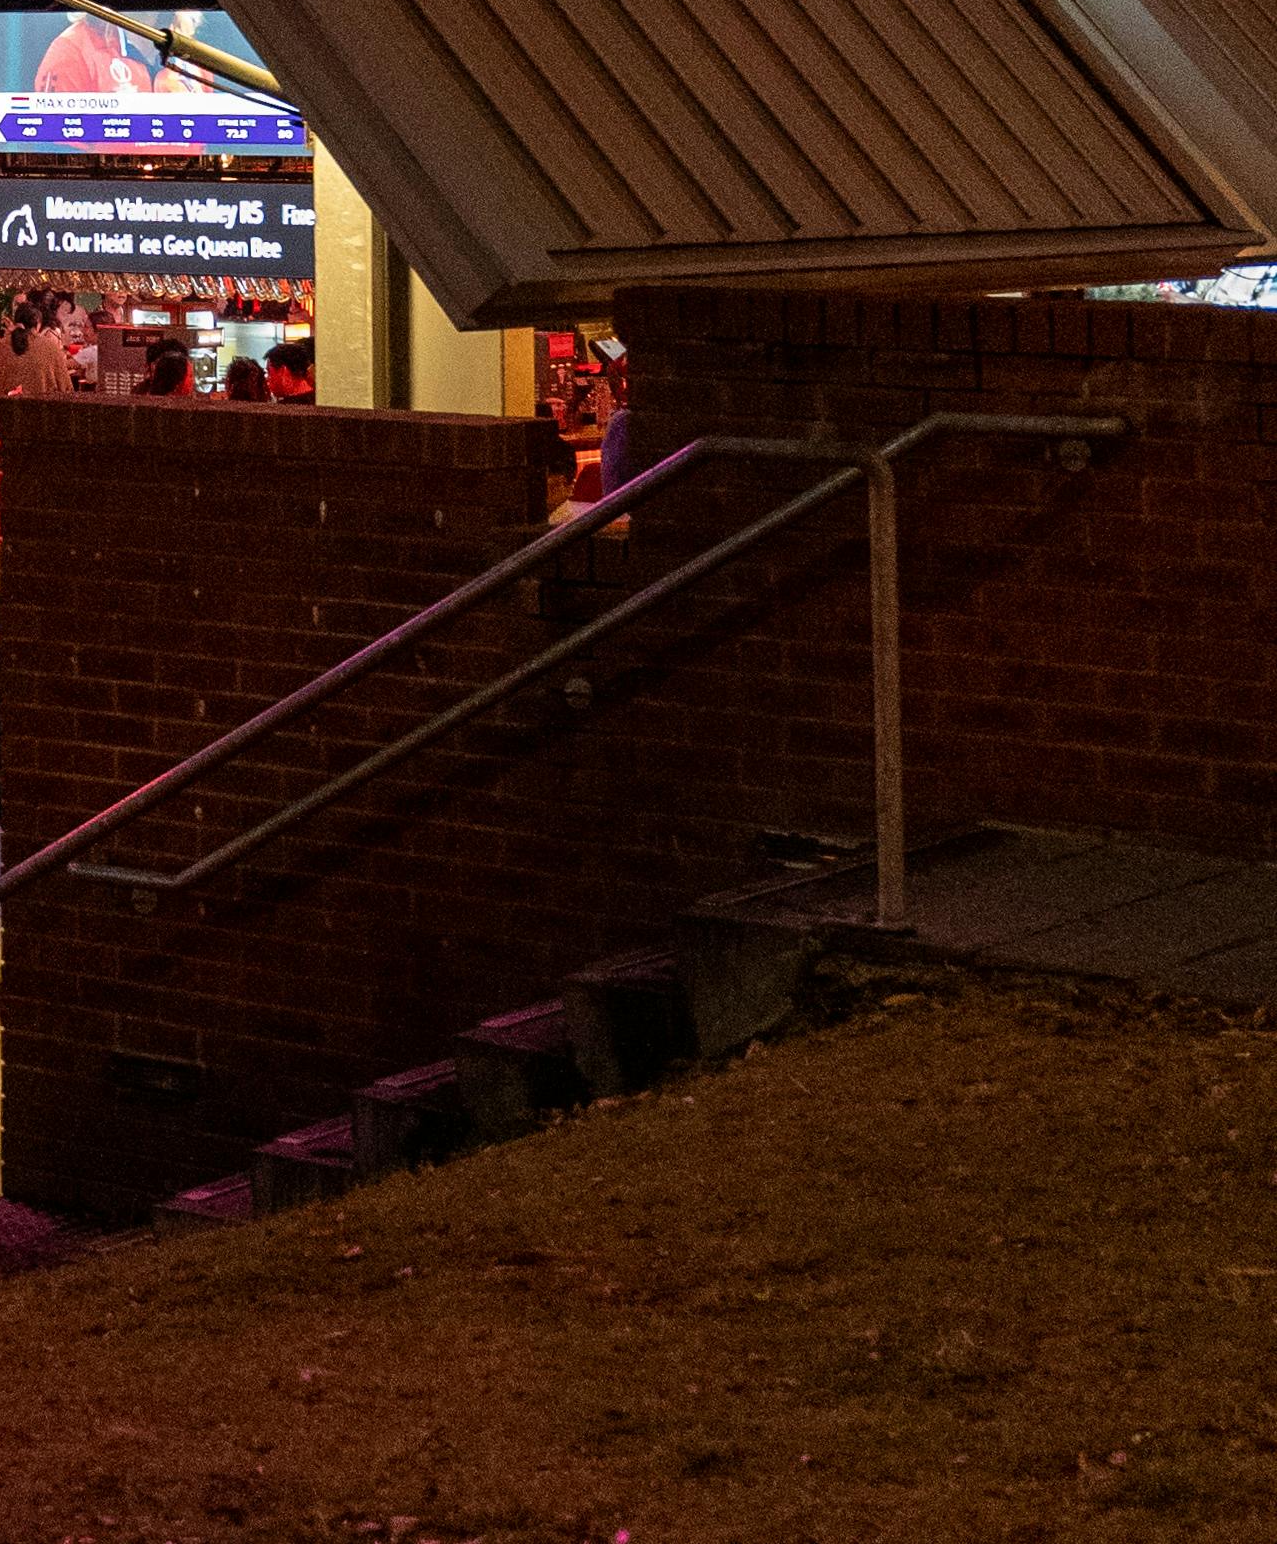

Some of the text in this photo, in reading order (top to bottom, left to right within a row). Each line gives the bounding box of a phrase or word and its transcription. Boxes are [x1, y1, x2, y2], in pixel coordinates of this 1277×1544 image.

[36, 98, 63, 108] MAX
[151, 128, 164, 138] 10
[45, 196, 114, 221] Moonee
[184, 198, 238, 230] Valley
[46, 231, 61, 252] 1.
[62, 232, 93, 253] Our
[93, 233, 134, 254] Heidi
[163, 235, 195, 256] Gee
[196, 235, 249, 260] Queen
[250, 237, 283, 258] Bee
